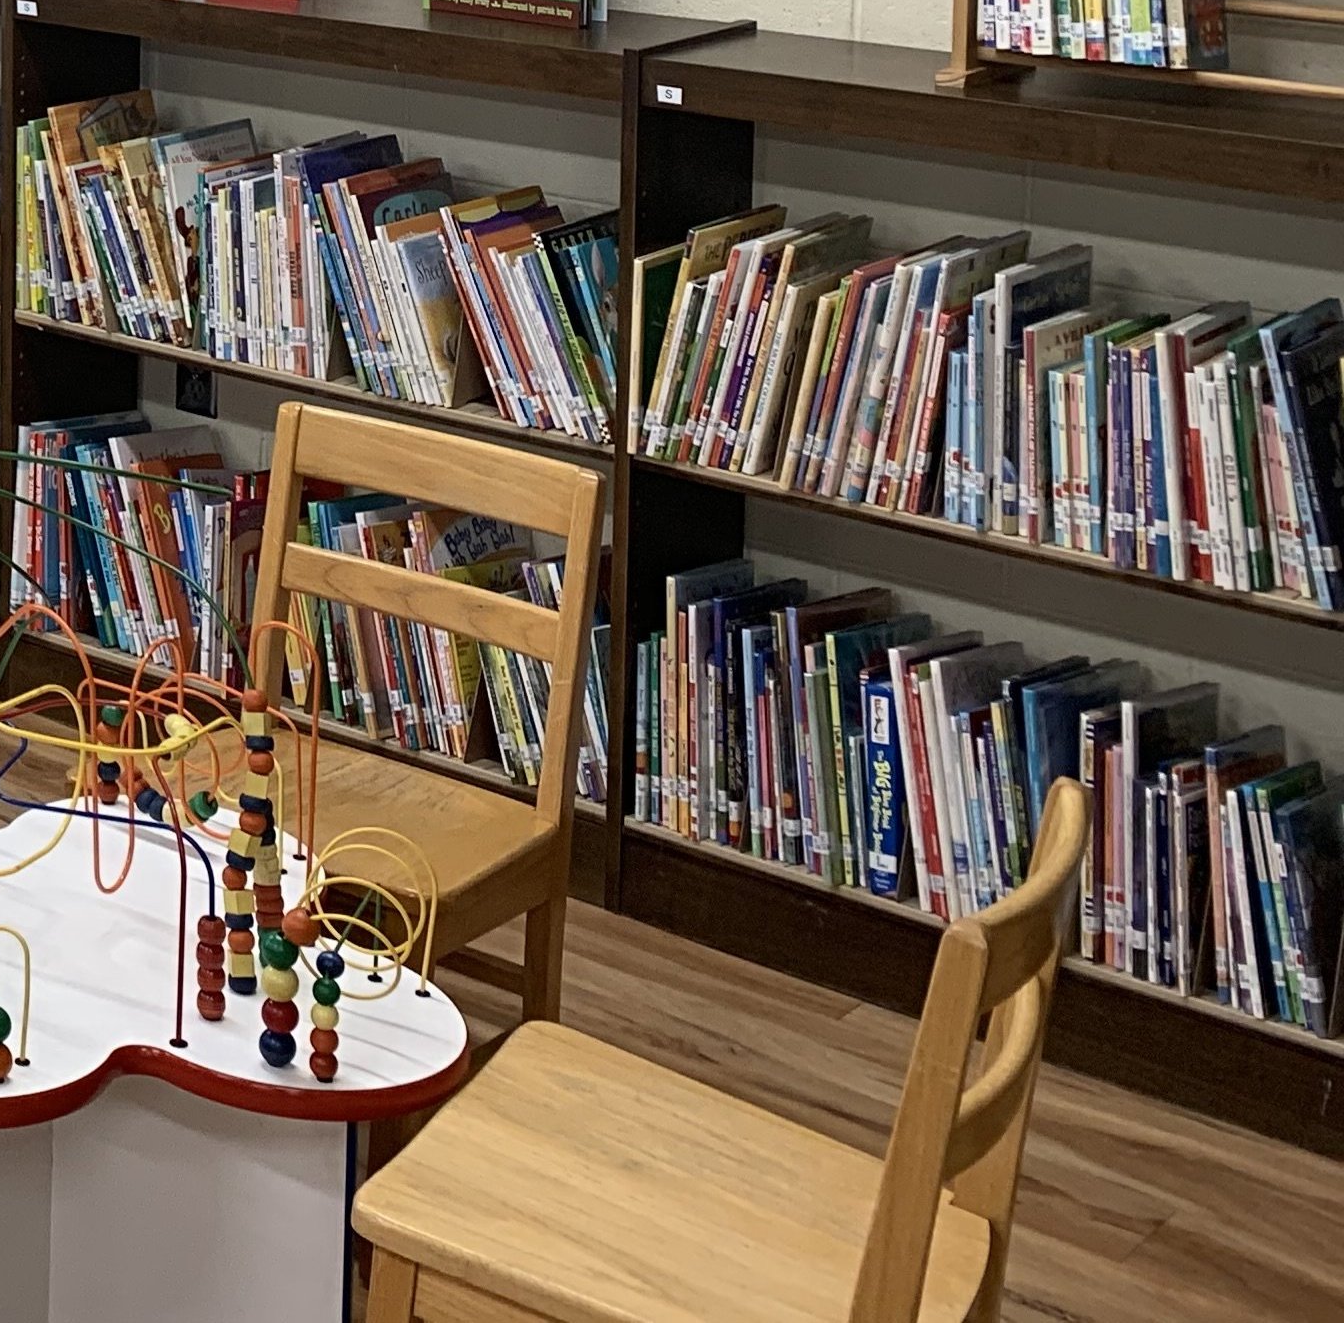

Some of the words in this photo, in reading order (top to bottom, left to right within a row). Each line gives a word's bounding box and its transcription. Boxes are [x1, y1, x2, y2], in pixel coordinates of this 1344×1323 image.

[23, 2, 31, 12] S
[664, 89, 674, 100] S
[416, 258, 448, 284] Sheep
[444, 526, 472, 554] Baby
[872, 759, 890, 788] BIG
